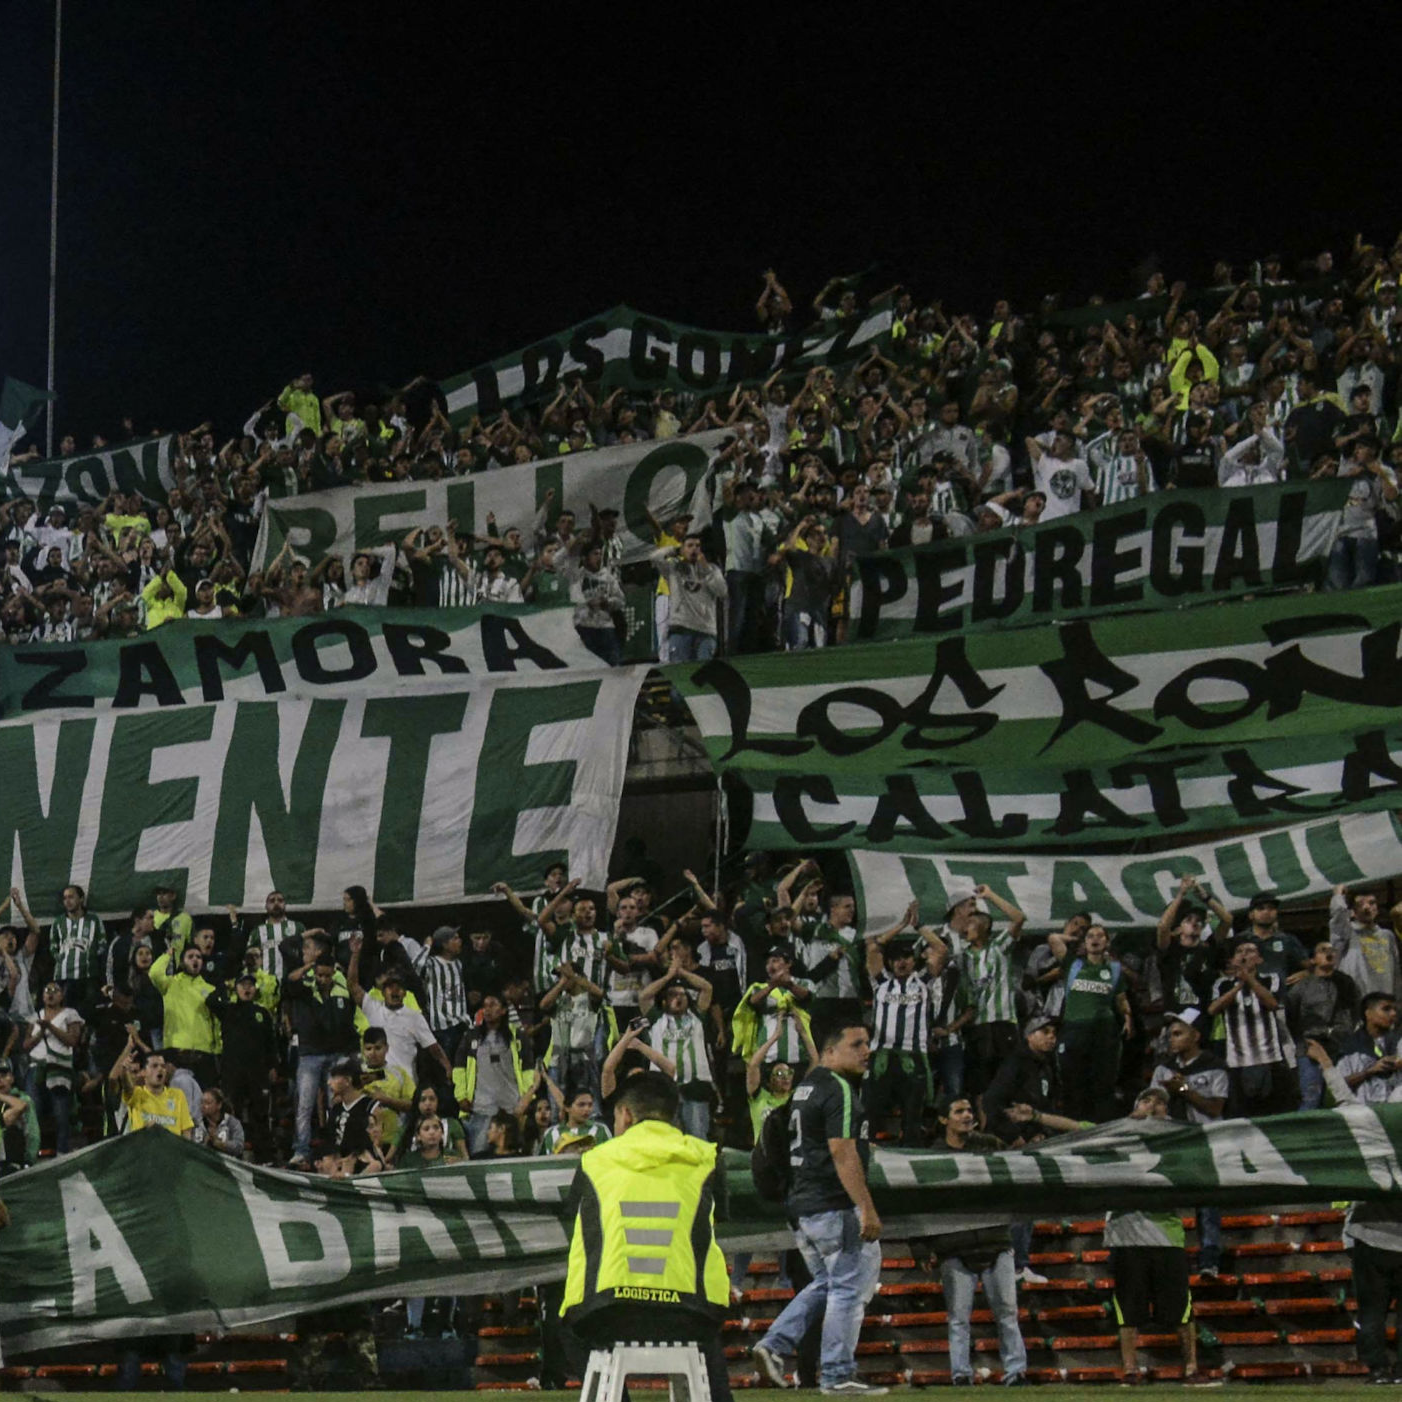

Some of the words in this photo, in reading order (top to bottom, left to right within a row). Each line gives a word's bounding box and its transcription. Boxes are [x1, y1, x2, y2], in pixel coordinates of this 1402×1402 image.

[264, 441, 710, 571] BELLO
[860, 491, 1327, 640] PEDREGAL
[13, 616, 569, 709] ZAMORA
[899, 820, 1369, 928] ITAGUI
[614, 1286, 682, 1304] LOGISTICA
